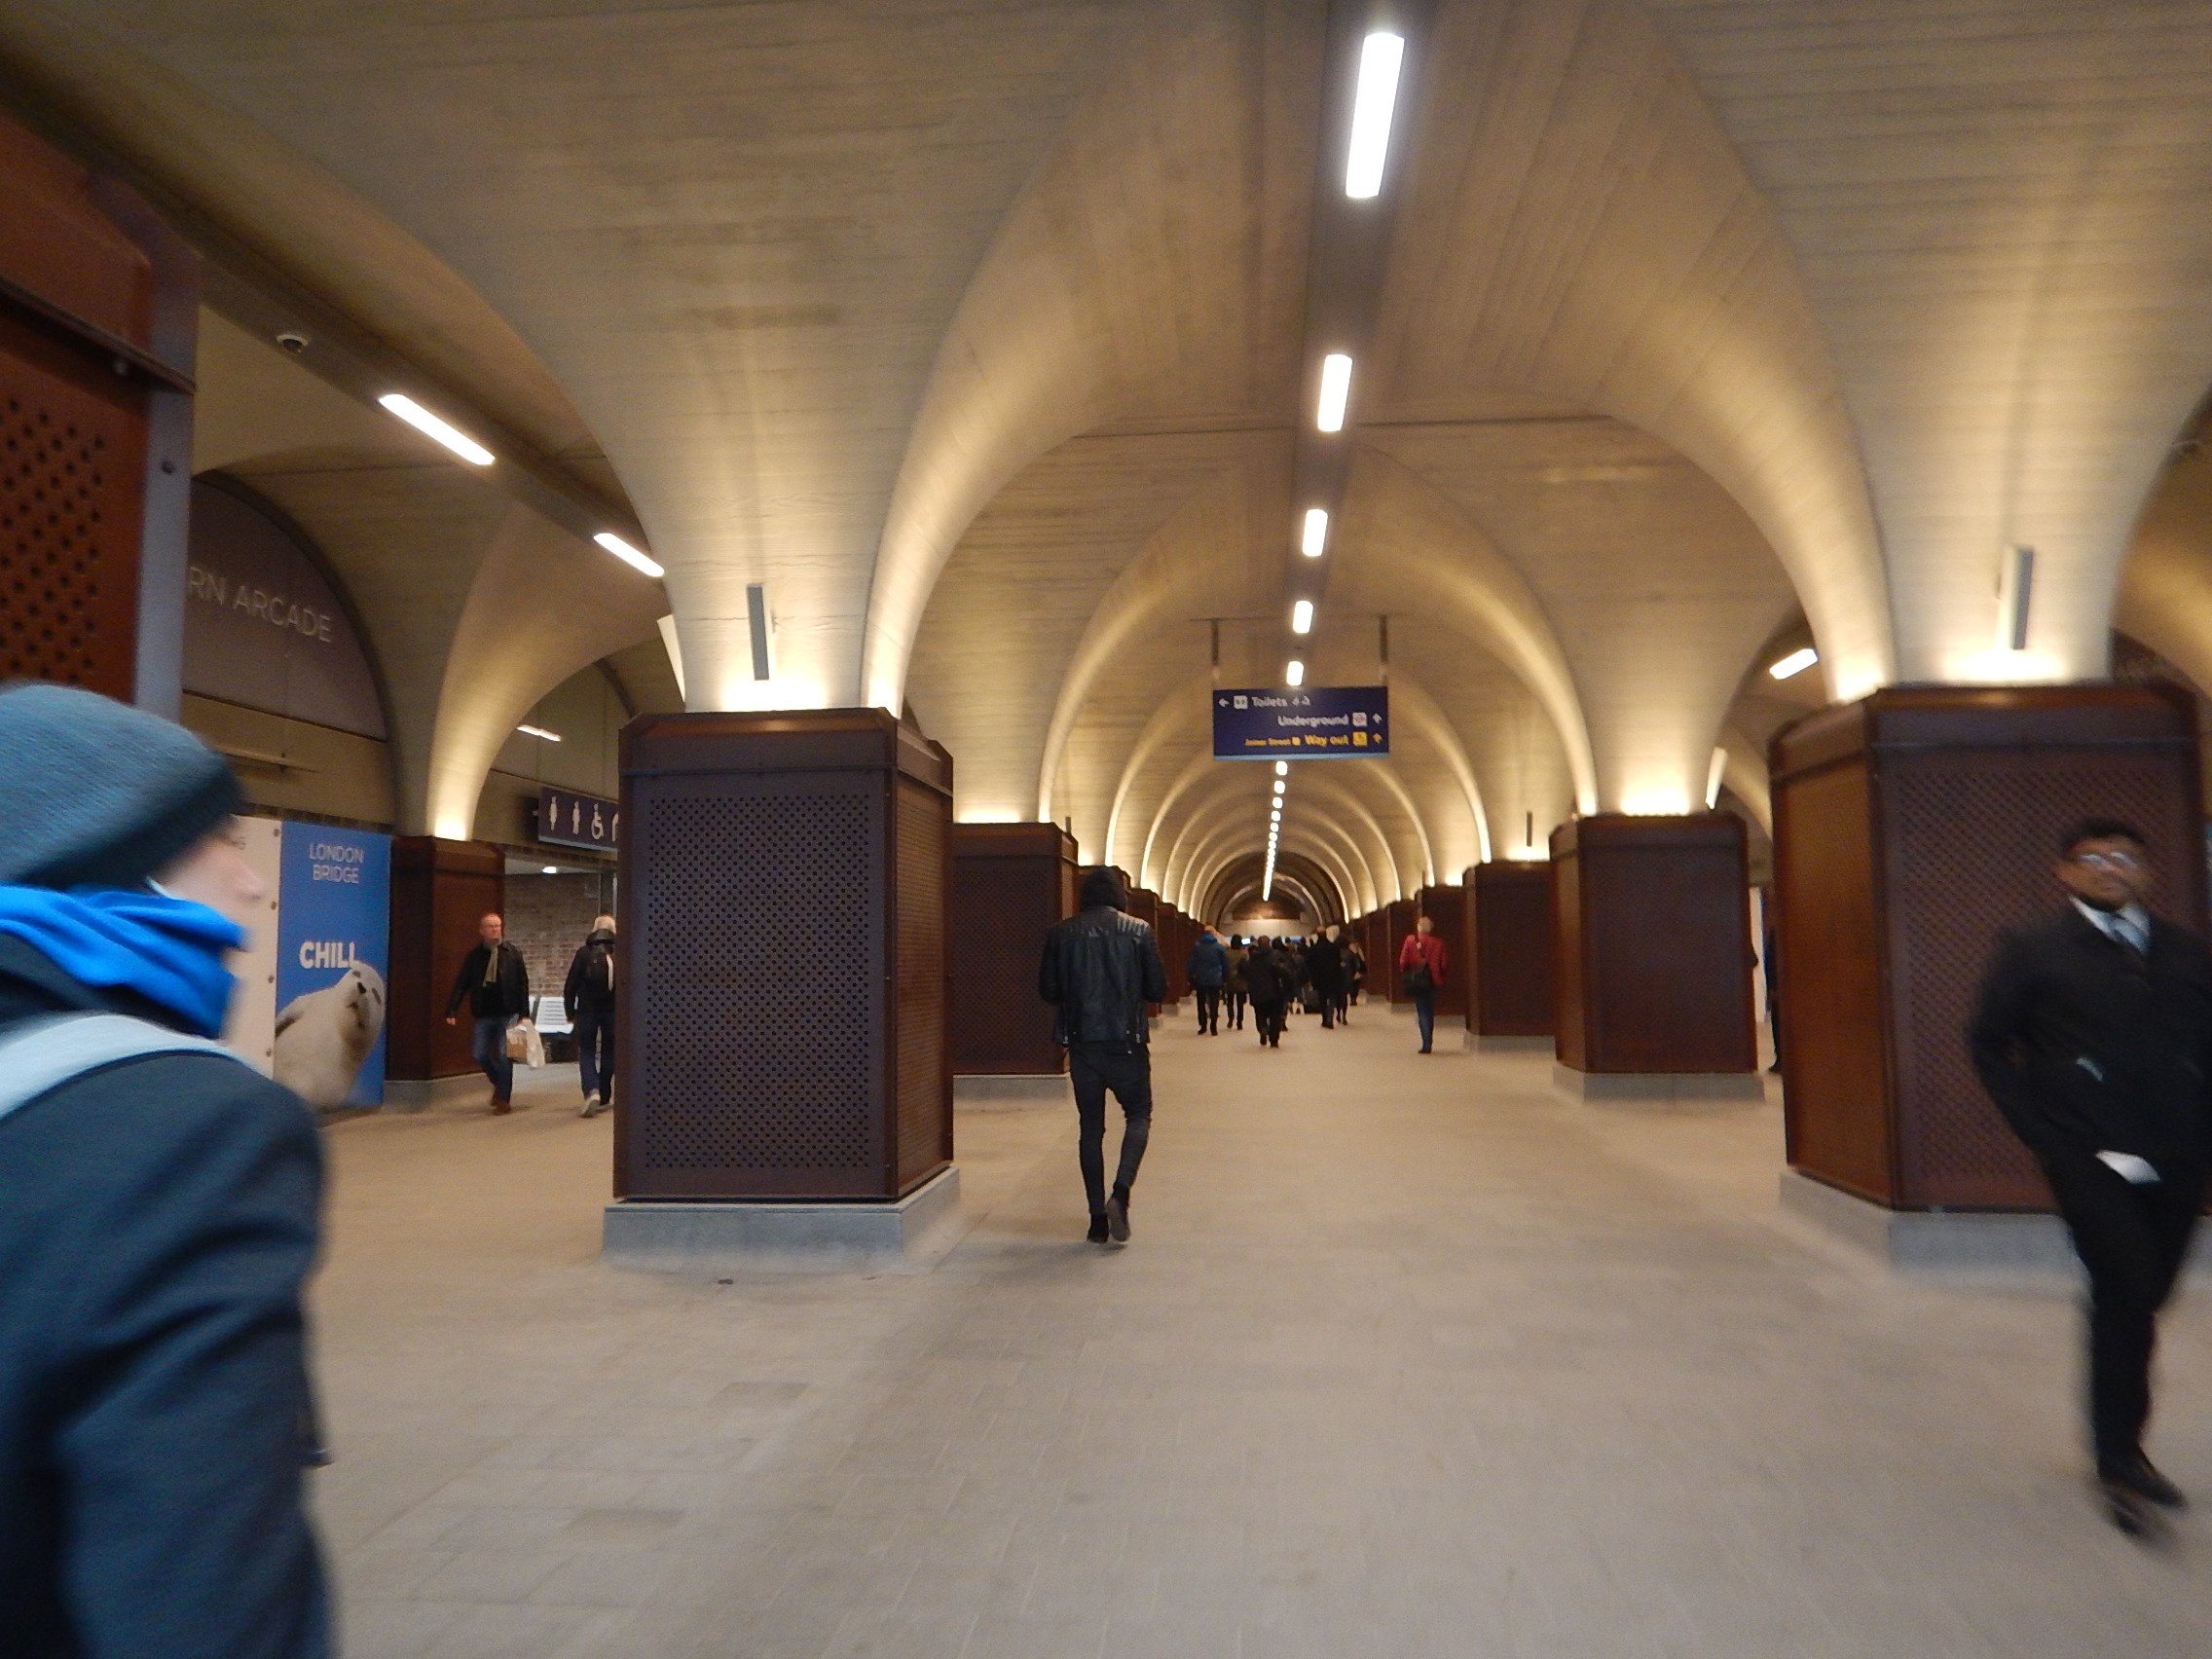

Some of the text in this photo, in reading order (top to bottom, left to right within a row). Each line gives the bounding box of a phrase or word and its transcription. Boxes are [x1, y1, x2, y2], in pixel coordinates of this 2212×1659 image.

[188, 566, 332, 643] RN ARCADE
[1252, 696, 1288, 708] Toilets
[1277, 714, 1349, 728] Underground
[1305, 734, 1328, 748] Way
[1329, 734, 1349, 746] out
[309, 843, 364, 864] LONDON
[313, 864, 359, 885] BRIDGE
[299, 941, 355, 970] CHILL
